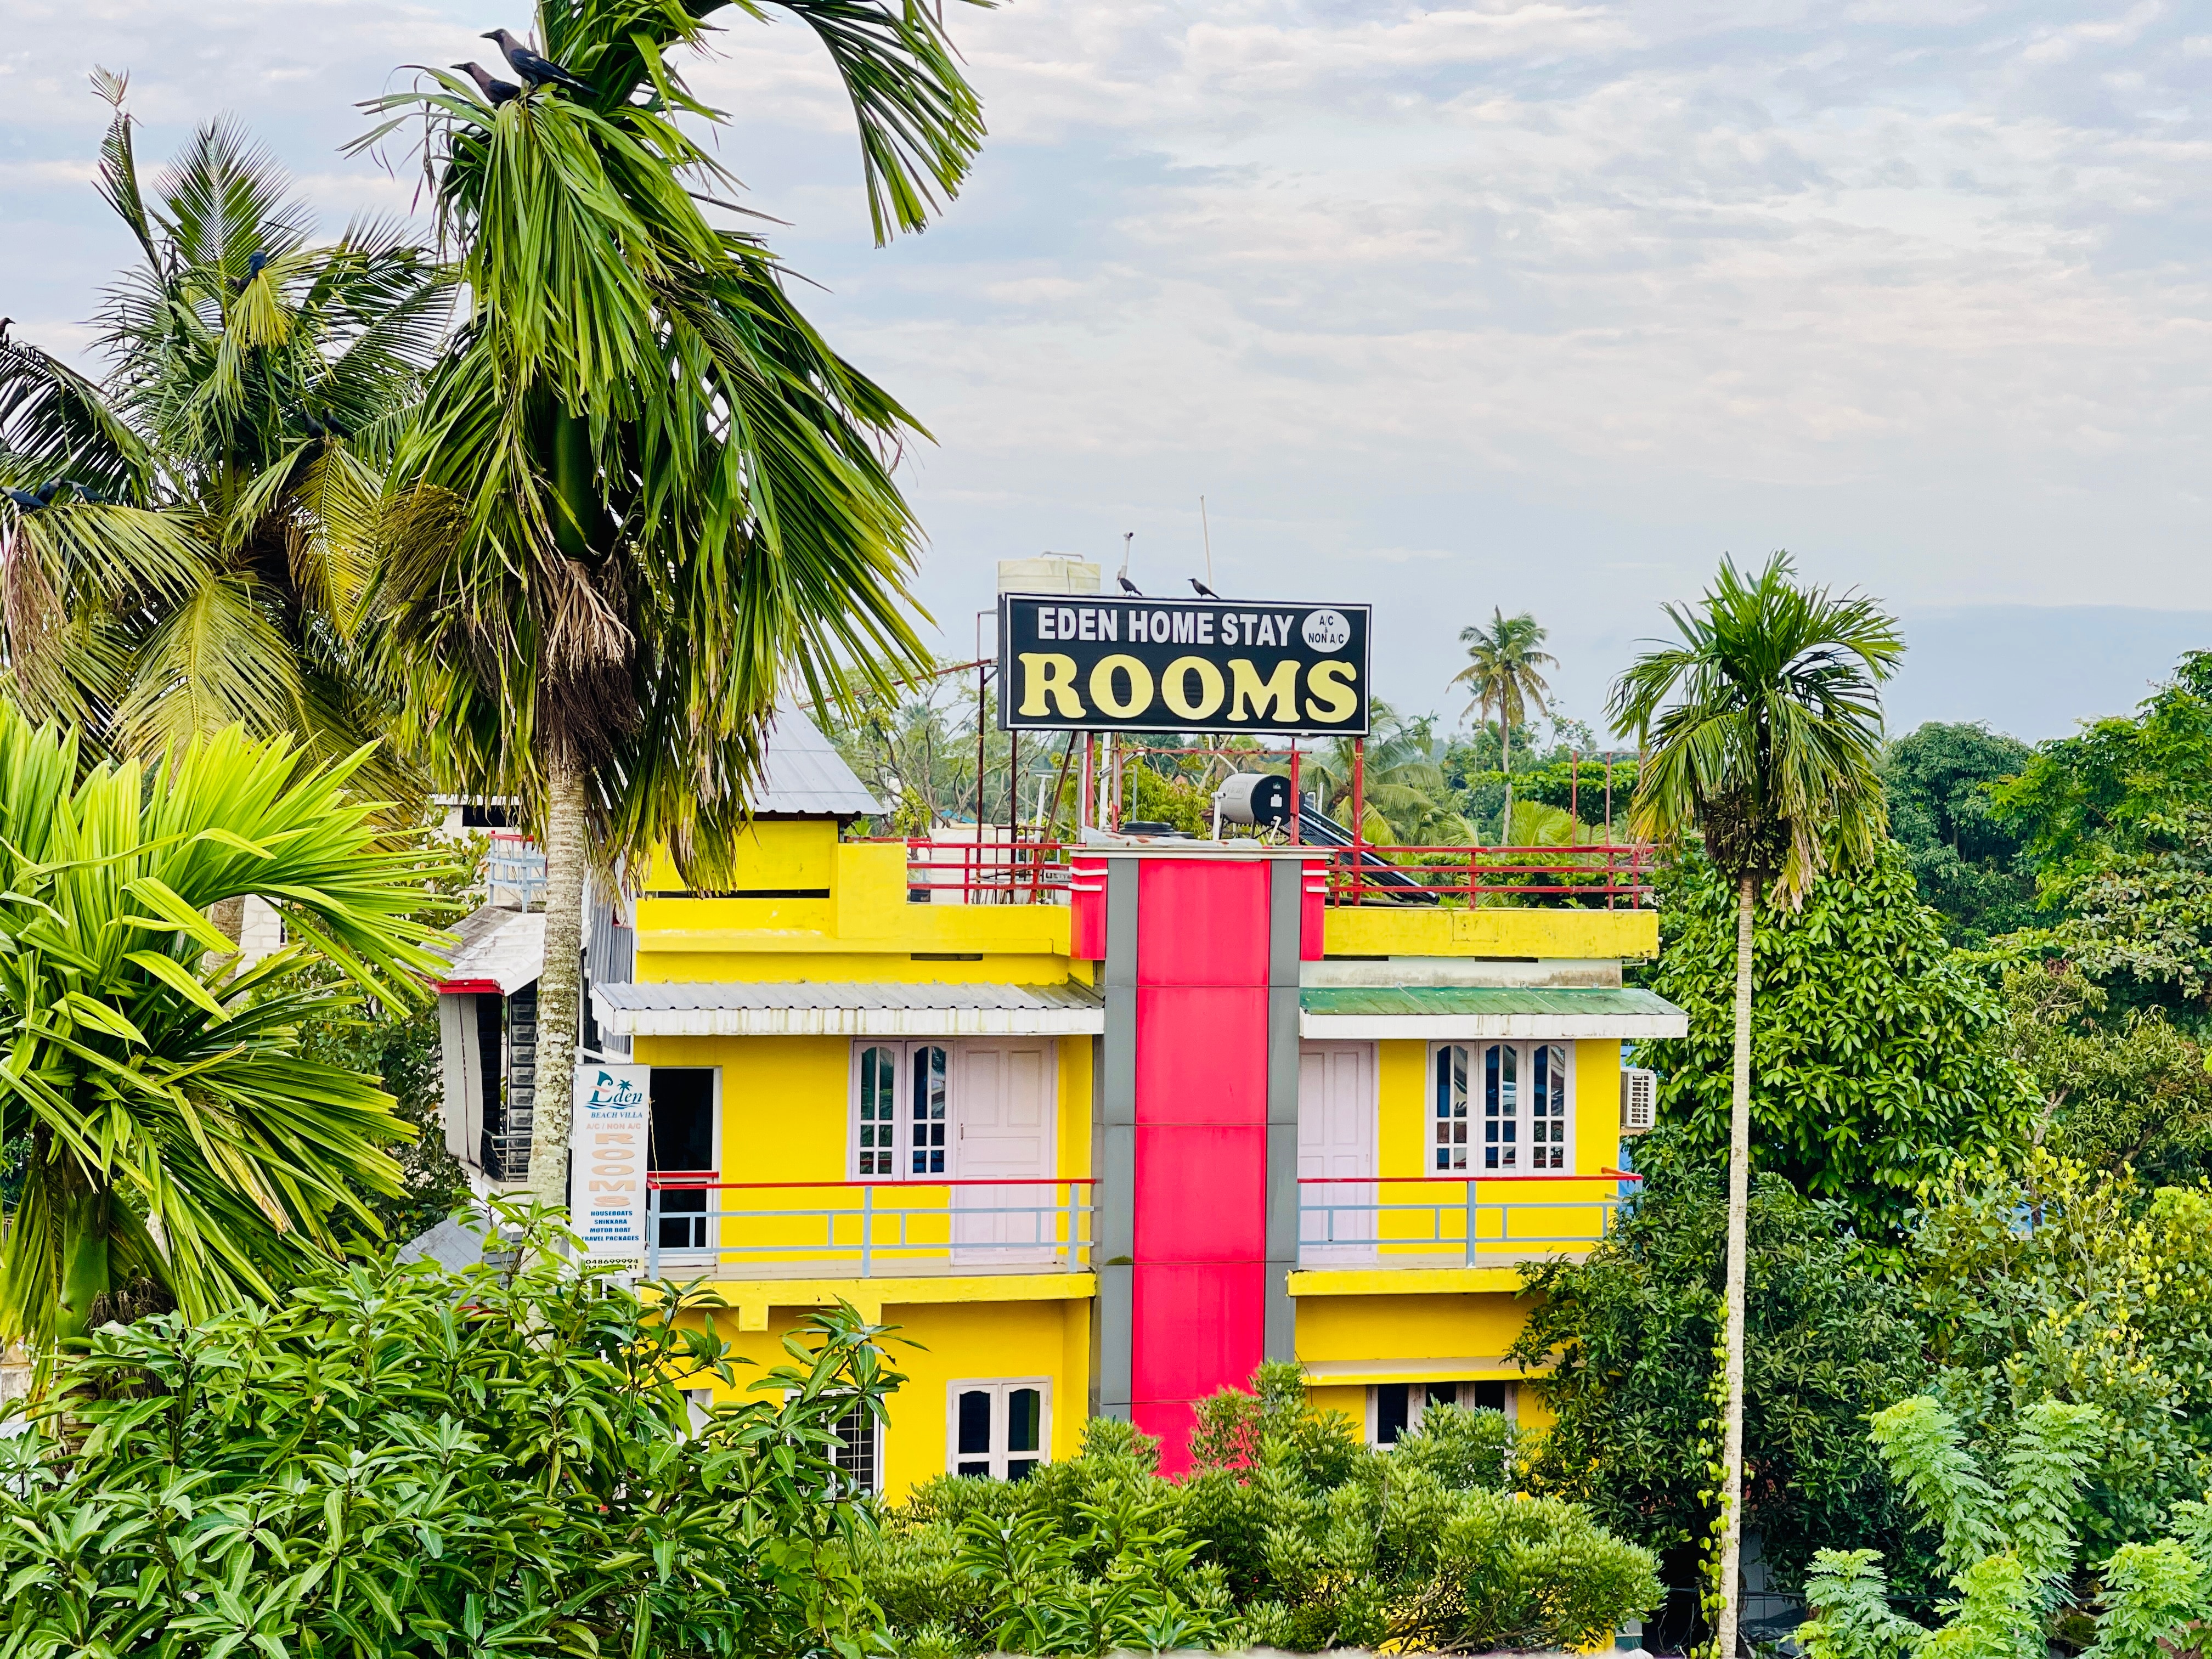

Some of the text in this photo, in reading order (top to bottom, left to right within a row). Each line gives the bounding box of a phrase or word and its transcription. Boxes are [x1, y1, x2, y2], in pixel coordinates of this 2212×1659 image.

[1038, 607, 1294, 647] EDEN HOME STAY
[1319, 615, 1333, 626] A/C
[1308, 633, 1344, 645] NON A/C
[1018, 652, 1358, 723] ROOMS
[587, 1070, 642, 1103] Eden
[589, 1133, 636, 1207] ROOMS
